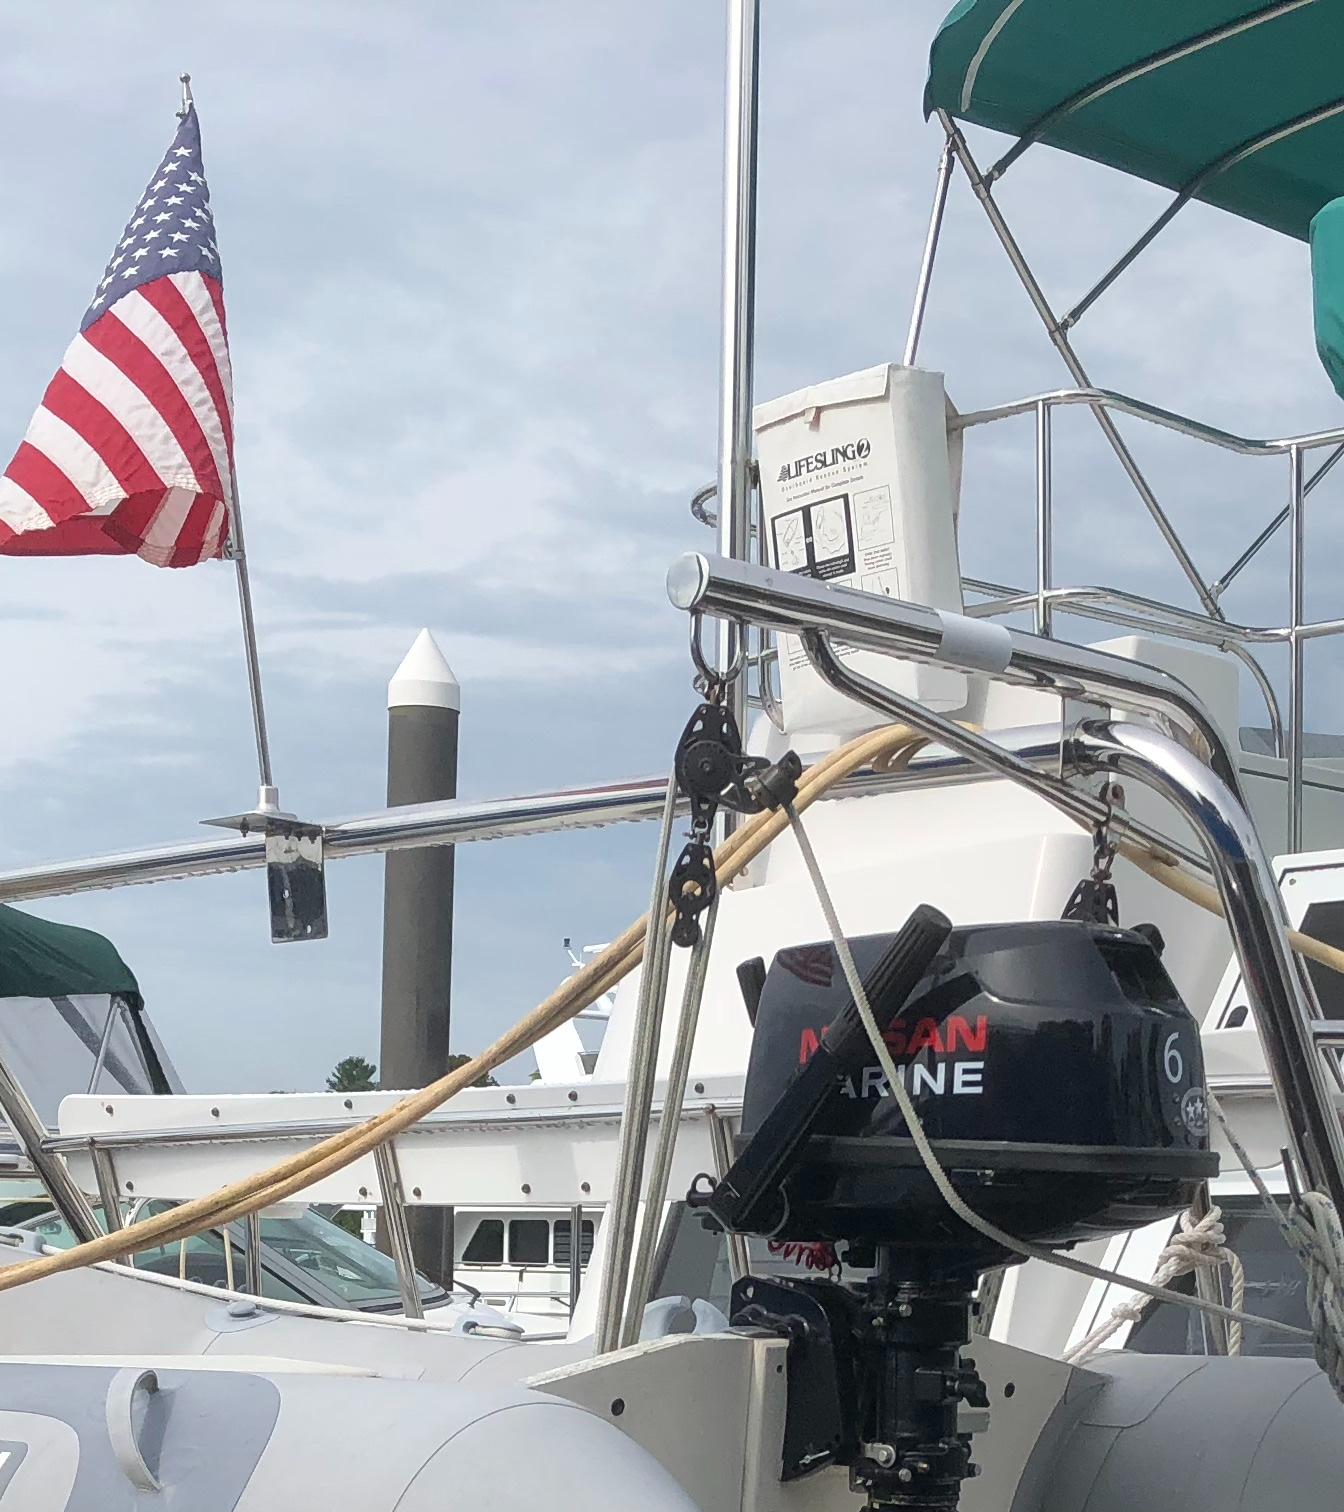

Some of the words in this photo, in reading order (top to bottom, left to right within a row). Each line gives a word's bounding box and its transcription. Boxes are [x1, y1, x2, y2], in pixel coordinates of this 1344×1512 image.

[787, 443, 856, 480] LIFESLING
[1164, 1031, 1183, 1084] 6
[836, 1060, 985, 1099] ARINE
